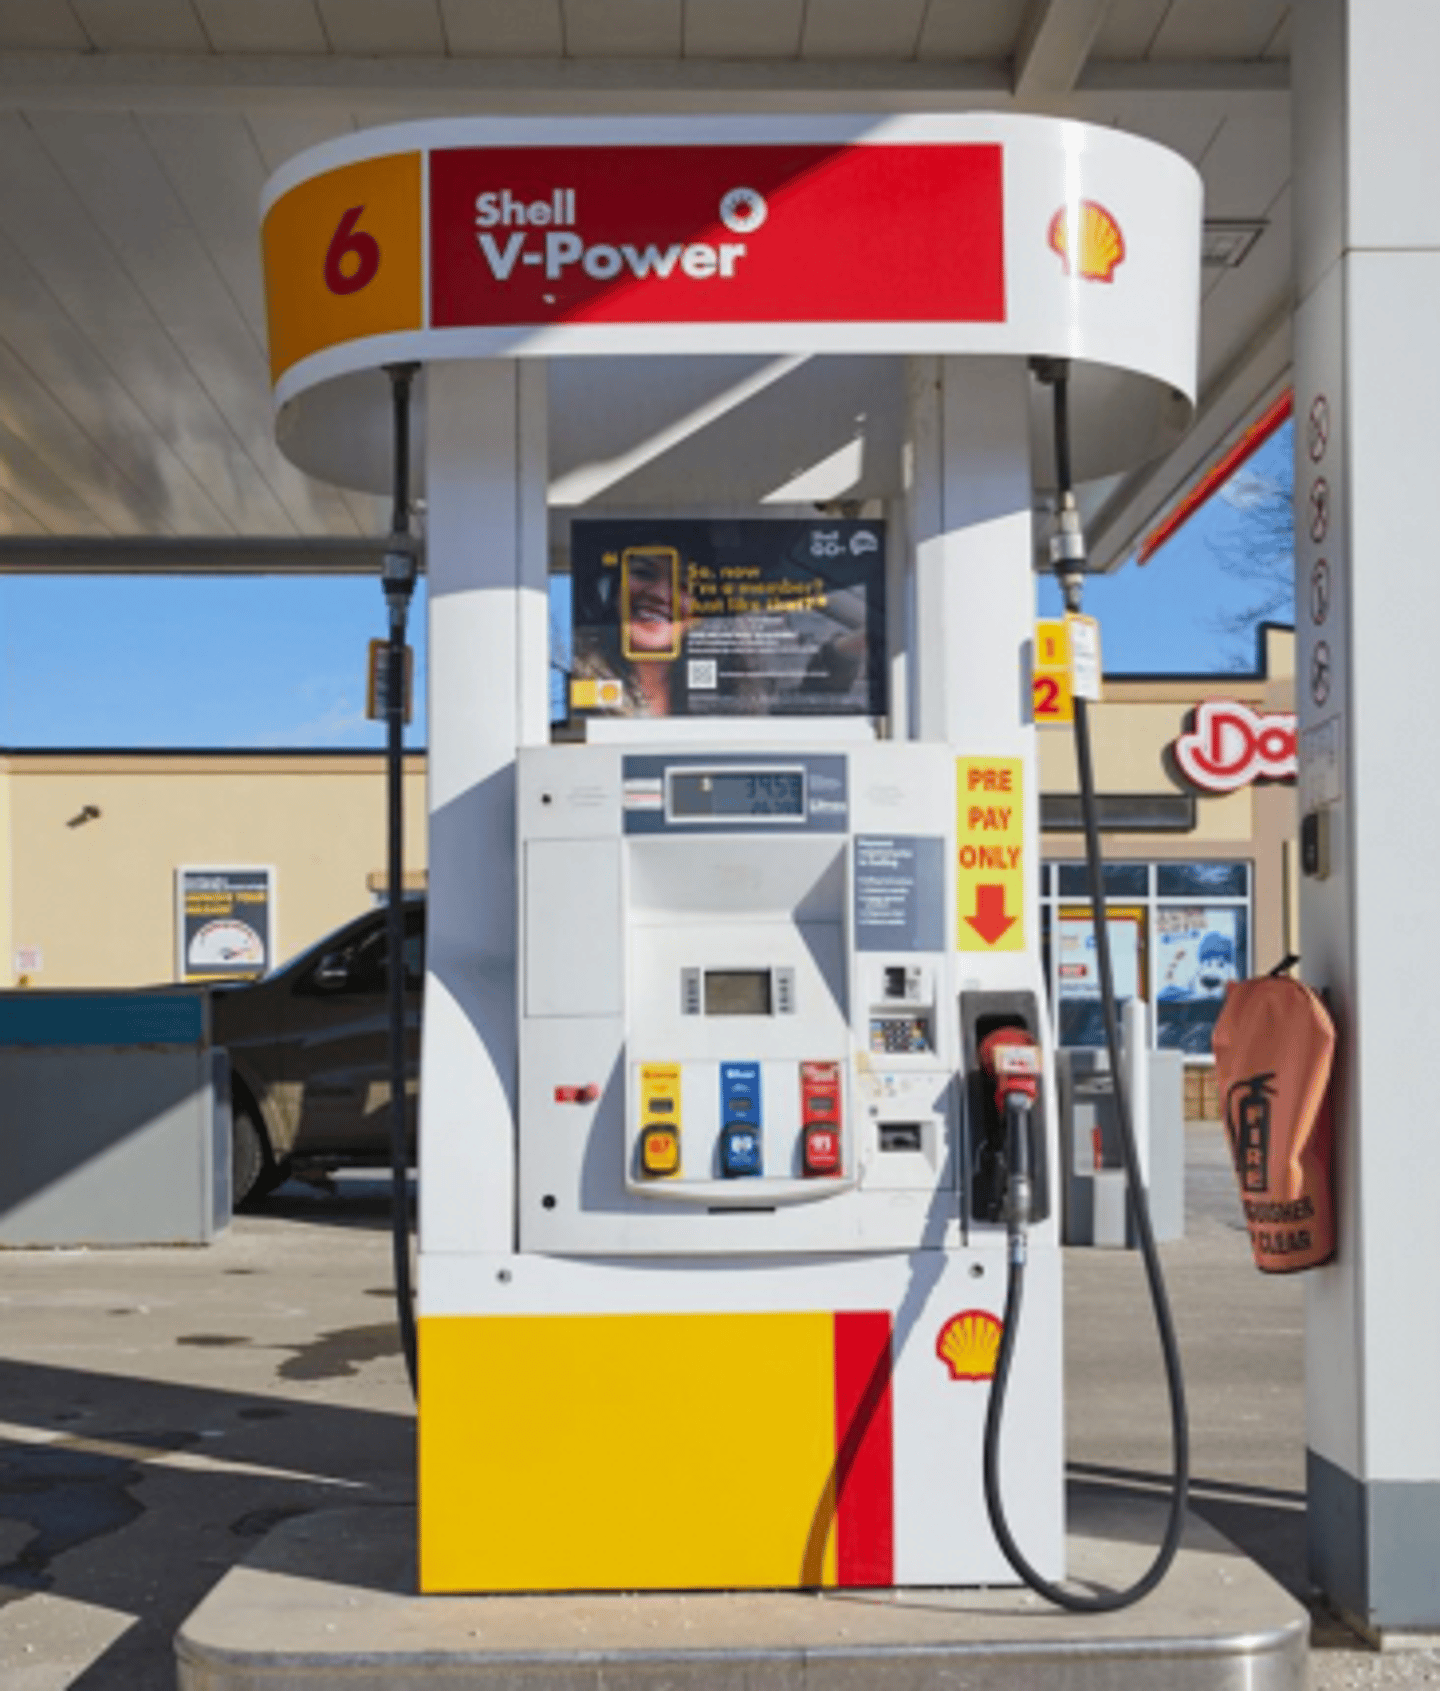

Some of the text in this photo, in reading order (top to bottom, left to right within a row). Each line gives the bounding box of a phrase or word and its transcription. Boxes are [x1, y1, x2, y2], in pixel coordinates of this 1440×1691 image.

[476, 190, 576, 226] Shell
[323, 205, 381, 295] 6
[477, 231, 747, 281] V-Power
[1045, 637, 1055, 658] 1
[1034, 677, 1060, 713] 2
[966, 768, 1013, 793] PRE
[966, 806, 1013, 831] PAY
[959, 845, 1022, 870] ONLY
